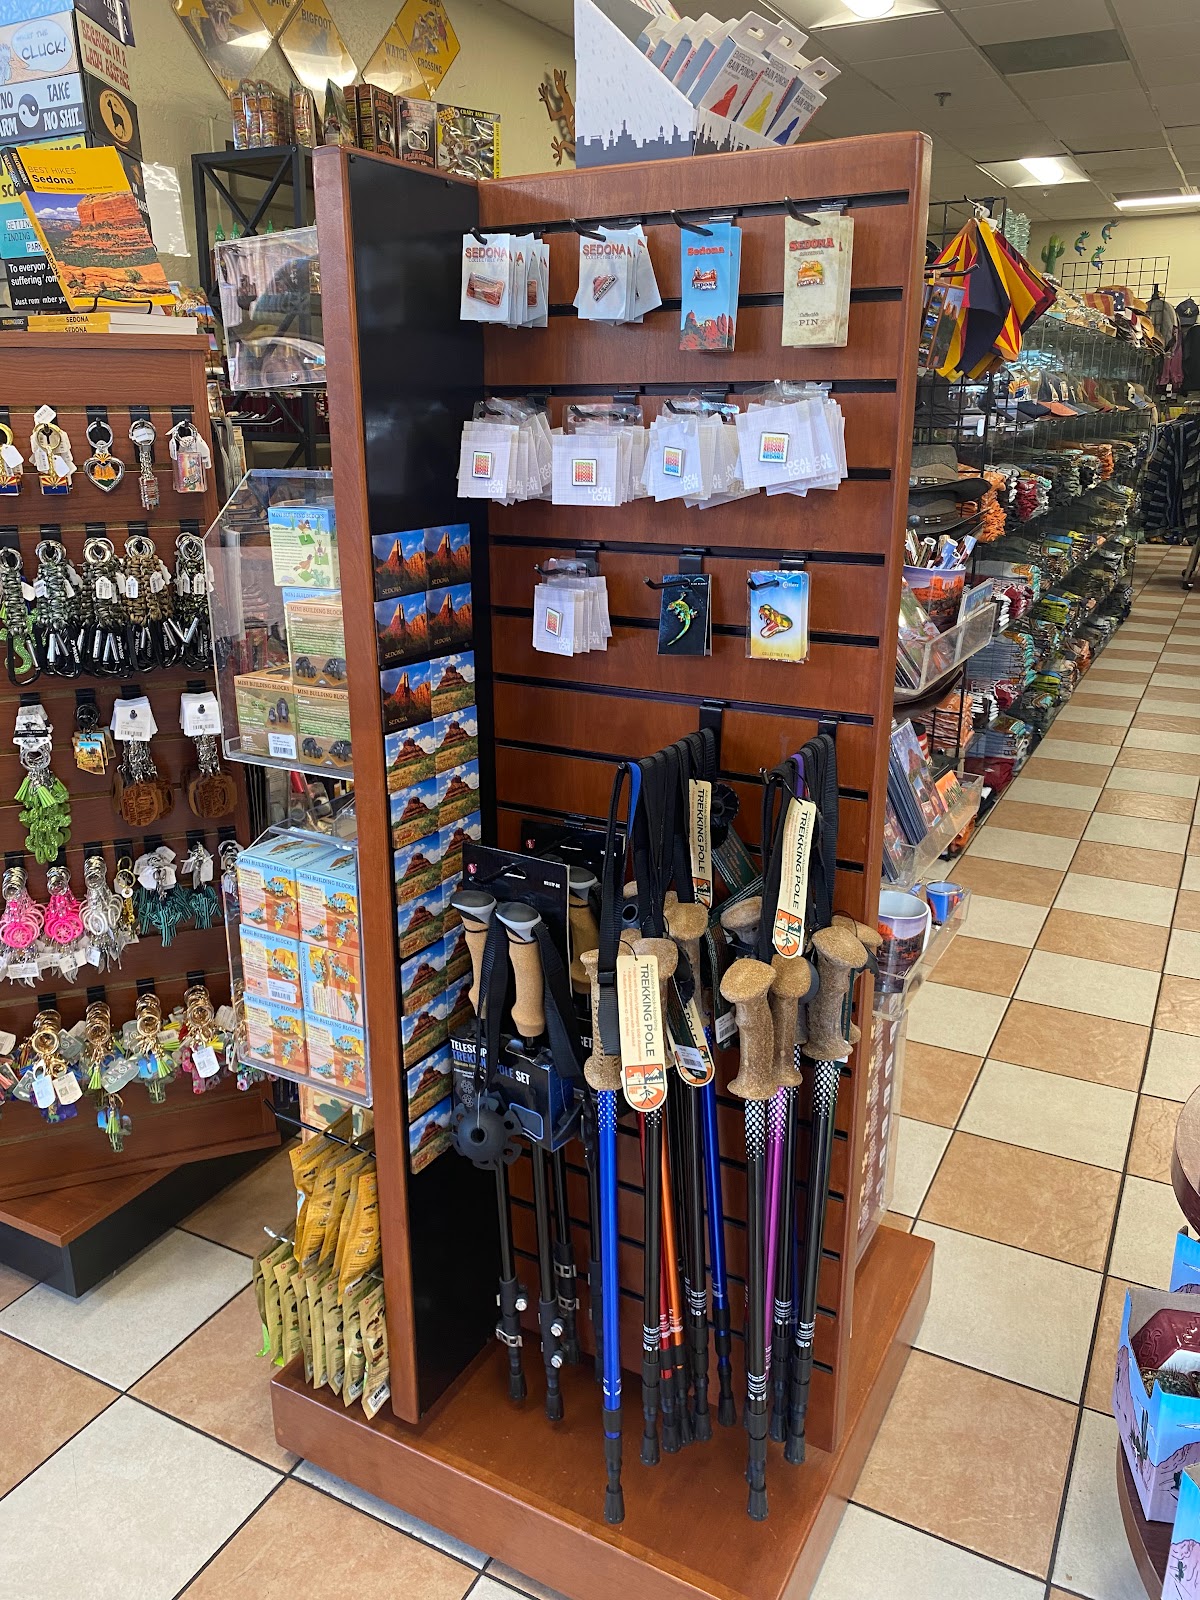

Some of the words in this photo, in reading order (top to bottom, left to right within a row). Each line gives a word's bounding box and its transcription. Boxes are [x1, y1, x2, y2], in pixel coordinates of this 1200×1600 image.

[300, 8, 332, 31] BIGFOOT
[21, 37, 67, 60] CLUCK!
[385, 42, 408, 62] WATCH
[418, 57, 443, 75] CROSSING
[727, 59, 740, 73] RAIN
[739, 65, 758, 81] PONCHO
[764, 67, 775, 80] RAIN
[1, 91, 13, 110] NO
[47, 81, 71, 102] TAKE
[794, 95, 804, 107] RAIN
[43, 110, 58, 131] NO
[60, 107, 82, 129] SHIT.
[51, 167, 77, 175] HIKES
[32, 175, 75, 185] Sedona
[7, 220, 33, 230] GETTIN
[4, 232, 30, 242] FINDING
[582, 244, 626, 256] SEDONA
[687, 246, 725, 257] Sedona
[789, 238, 835, 252] SEDONA
[465, 247, 508, 259] SEDONA
[8, 264, 18, 273] To
[19, 262, 50, 273] everyon
[45, 248, 61, 280] SEDONA
[11, 275, 42, 286] suffering
[42, 274, 59, 283] rom
[14, 296, 27, 306] Just
[28, 296, 57, 304] remmber
[58, 296, 66, 304] yo
[176, 298, 198, 312] Sedona
[697, 320, 712, 328] PIN
[799, 318, 819, 326] PIN
[783, 457, 811, 470] LOCAL
[788, 466, 812, 476] LOVE
[485, 479, 504, 487] LOCAL
[684, 482, 699, 490] LOVE
[431, 577, 449, 586] SEDONA
[382, 586, 402, 595] SEDONA
[434, 636, 452, 646] SEDONA
[385, 649, 404, 659] SEDONA
[249, 681, 272, 690] BUILDING
[272, 684, 290, 692] BLOCKS
[310, 690, 333, 699] BUILDING
[389, 716, 408, 726] SEDONA
[696, 789, 705, 843] TREKKING
[795, 811, 809, 872] TREKKING
[697, 845, 705, 873] POLE
[240, 857, 251, 865] MINI
[251, 860, 273, 870] BUILDING
[273, 865, 291, 875] BLOCKS
[312, 875, 335, 886] BUILDING
[336, 881, 354, 891] BLOCKS
[792, 875, 802, 910] POLE
[253, 931, 275, 942] BUILDING
[275, 937, 293, 946] BLOCKS
[640, 964, 652, 1021] TREKKING
[258, 998, 280, 1009] BUILDING
[281, 1004, 298, 1014] BLOCKS
[307, 1014, 319, 1022] MINI
[320, 1017, 342, 1029] BUILDING
[342, 1024, 361, 1034] BLOCKS
[644, 1024, 655, 1057] POLE
[515, 1070, 531, 1085] SET
